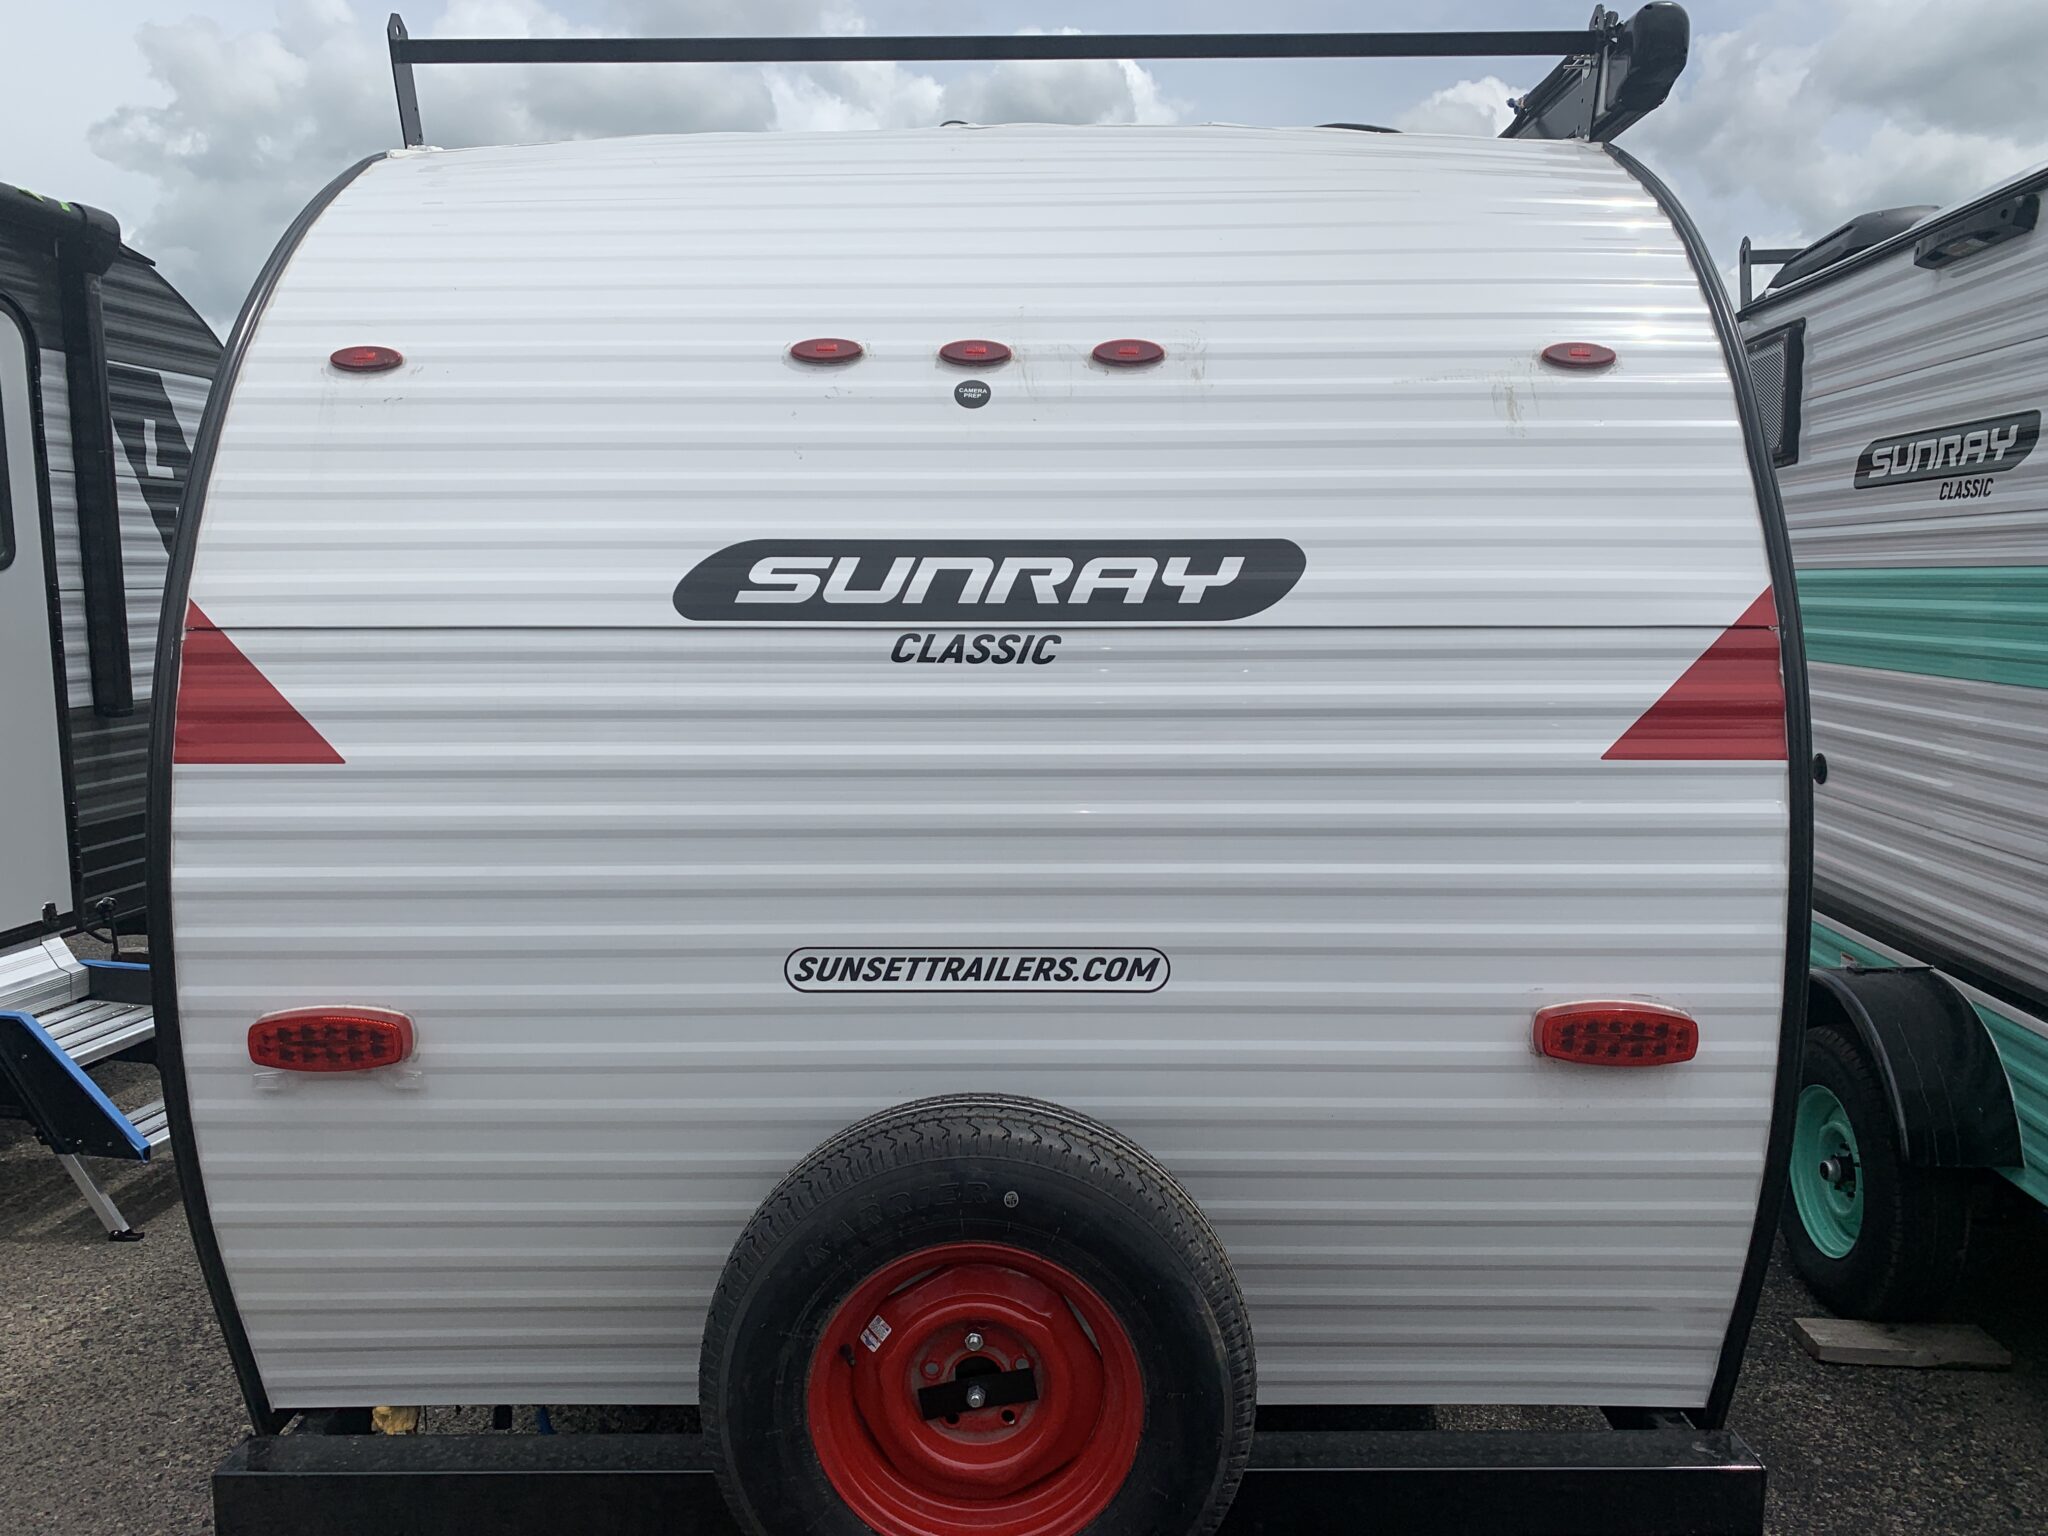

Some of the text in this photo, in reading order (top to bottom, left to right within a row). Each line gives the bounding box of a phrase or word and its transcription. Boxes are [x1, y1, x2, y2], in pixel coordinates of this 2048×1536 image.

[1868, 424, 2019, 479] SUNRAY
[1939, 478, 1994, 500] CLASSIC
[734, 556, 1246, 604] SUNRAY
[890, 633, 1062, 665] CLASSIC
[794, 956, 1161, 983] SUNSETTRAILERS.COM
